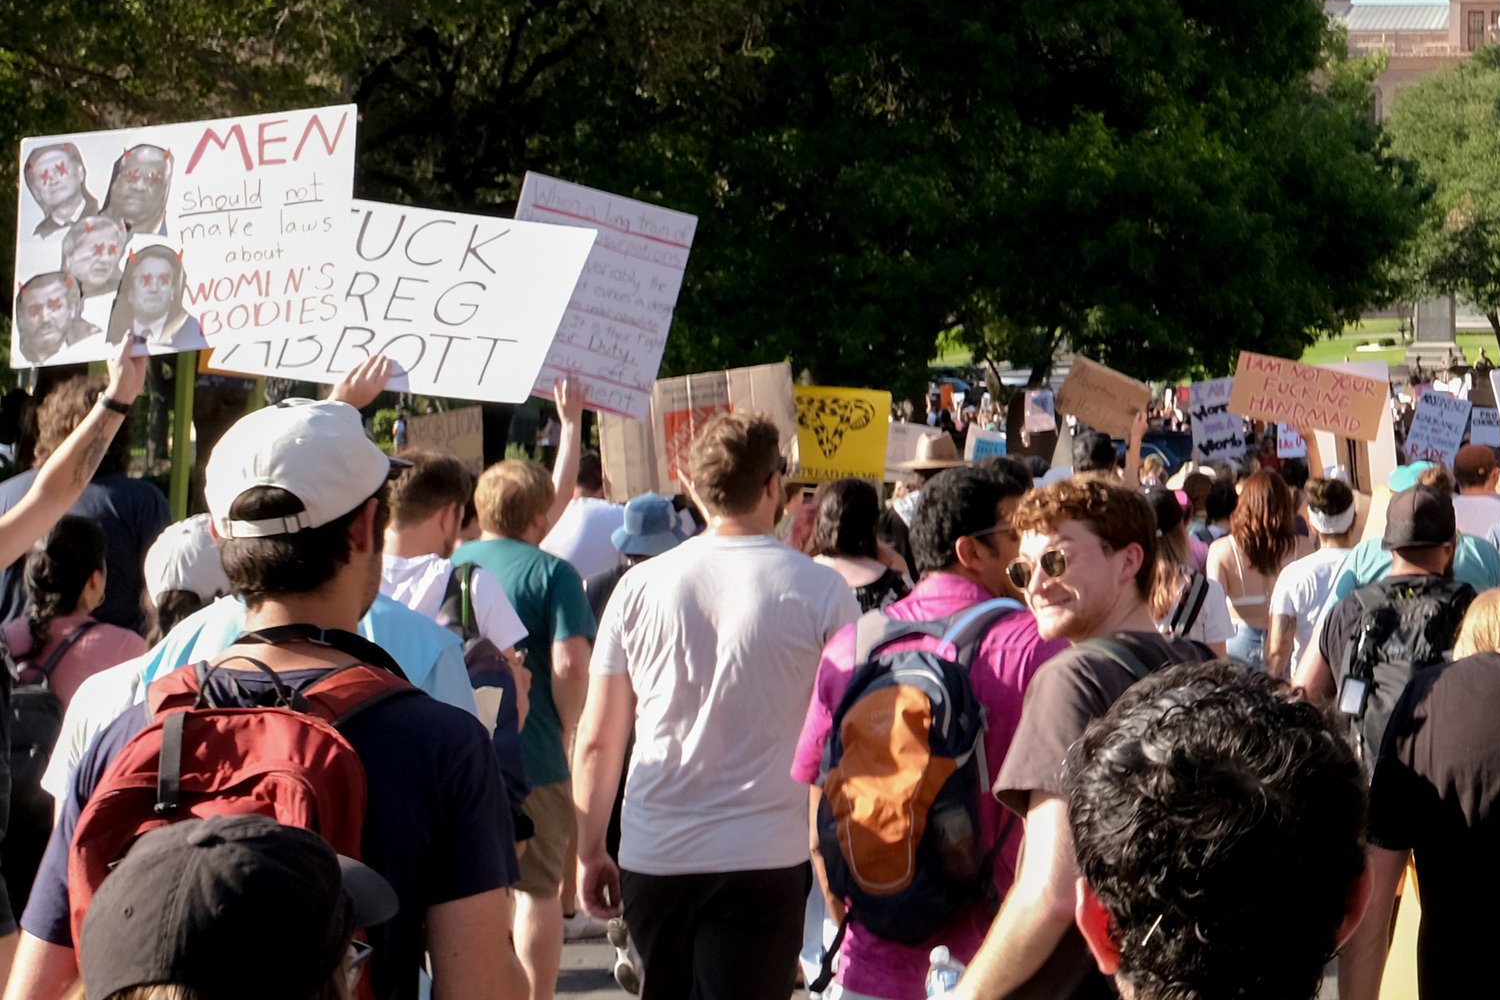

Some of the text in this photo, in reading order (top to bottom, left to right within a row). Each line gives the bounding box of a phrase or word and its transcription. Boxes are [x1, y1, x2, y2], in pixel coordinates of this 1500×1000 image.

[185, 111, 348, 175] MEN
[181, 171, 323, 211] should not
[179, 208, 332, 244] make laws
[351, 208, 511, 275] UCK
[225, 241, 285, 263] about
[587, 260, 641, 296] variably
[199, 294, 338, 337] BODIES
[345, 271, 487, 327] REG
[1253, 358, 1282, 374] AM
[1289, 364, 1321, 384] NOT
[1330, 371, 1377, 398] YOUR
[1263, 376, 1350, 409] FUCKING
[1249, 394, 1361, 433] HANDMAID
